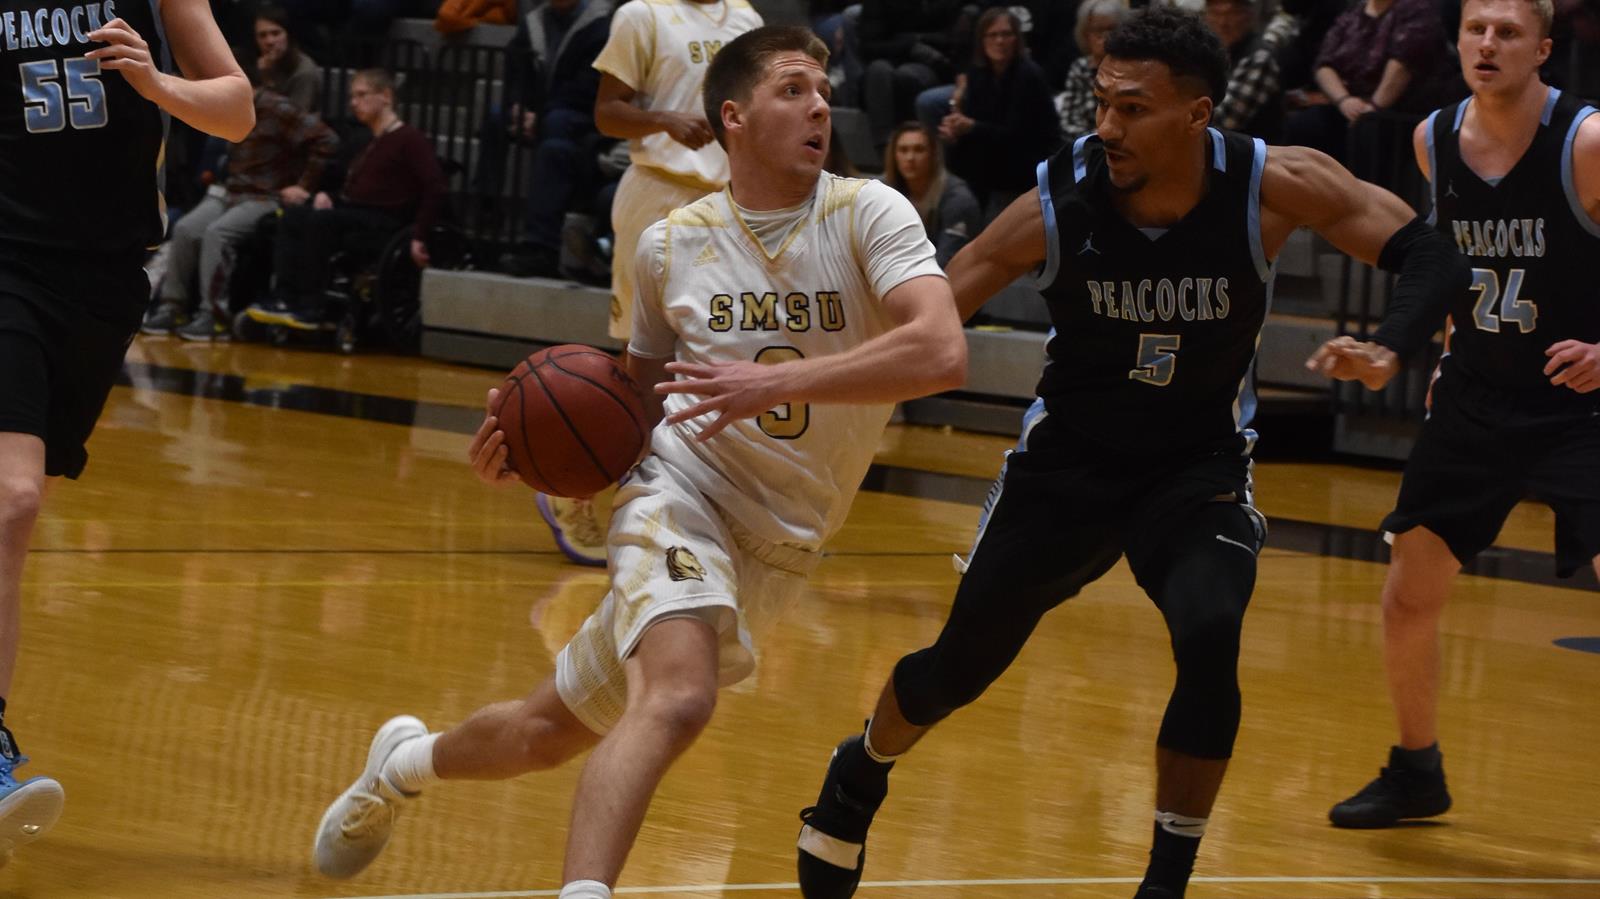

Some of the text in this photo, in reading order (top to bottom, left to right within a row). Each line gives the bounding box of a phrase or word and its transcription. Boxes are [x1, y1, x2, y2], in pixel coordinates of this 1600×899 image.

[0, 0, 116, 50] EACOCKS
[19, 58, 108, 134] 55
[708, 291, 846, 332] SMSU
[1087, 277, 1230, 322] PEACOCKS
[1469, 268, 1538, 334] 24
[1128, 333, 1181, 386] 5
